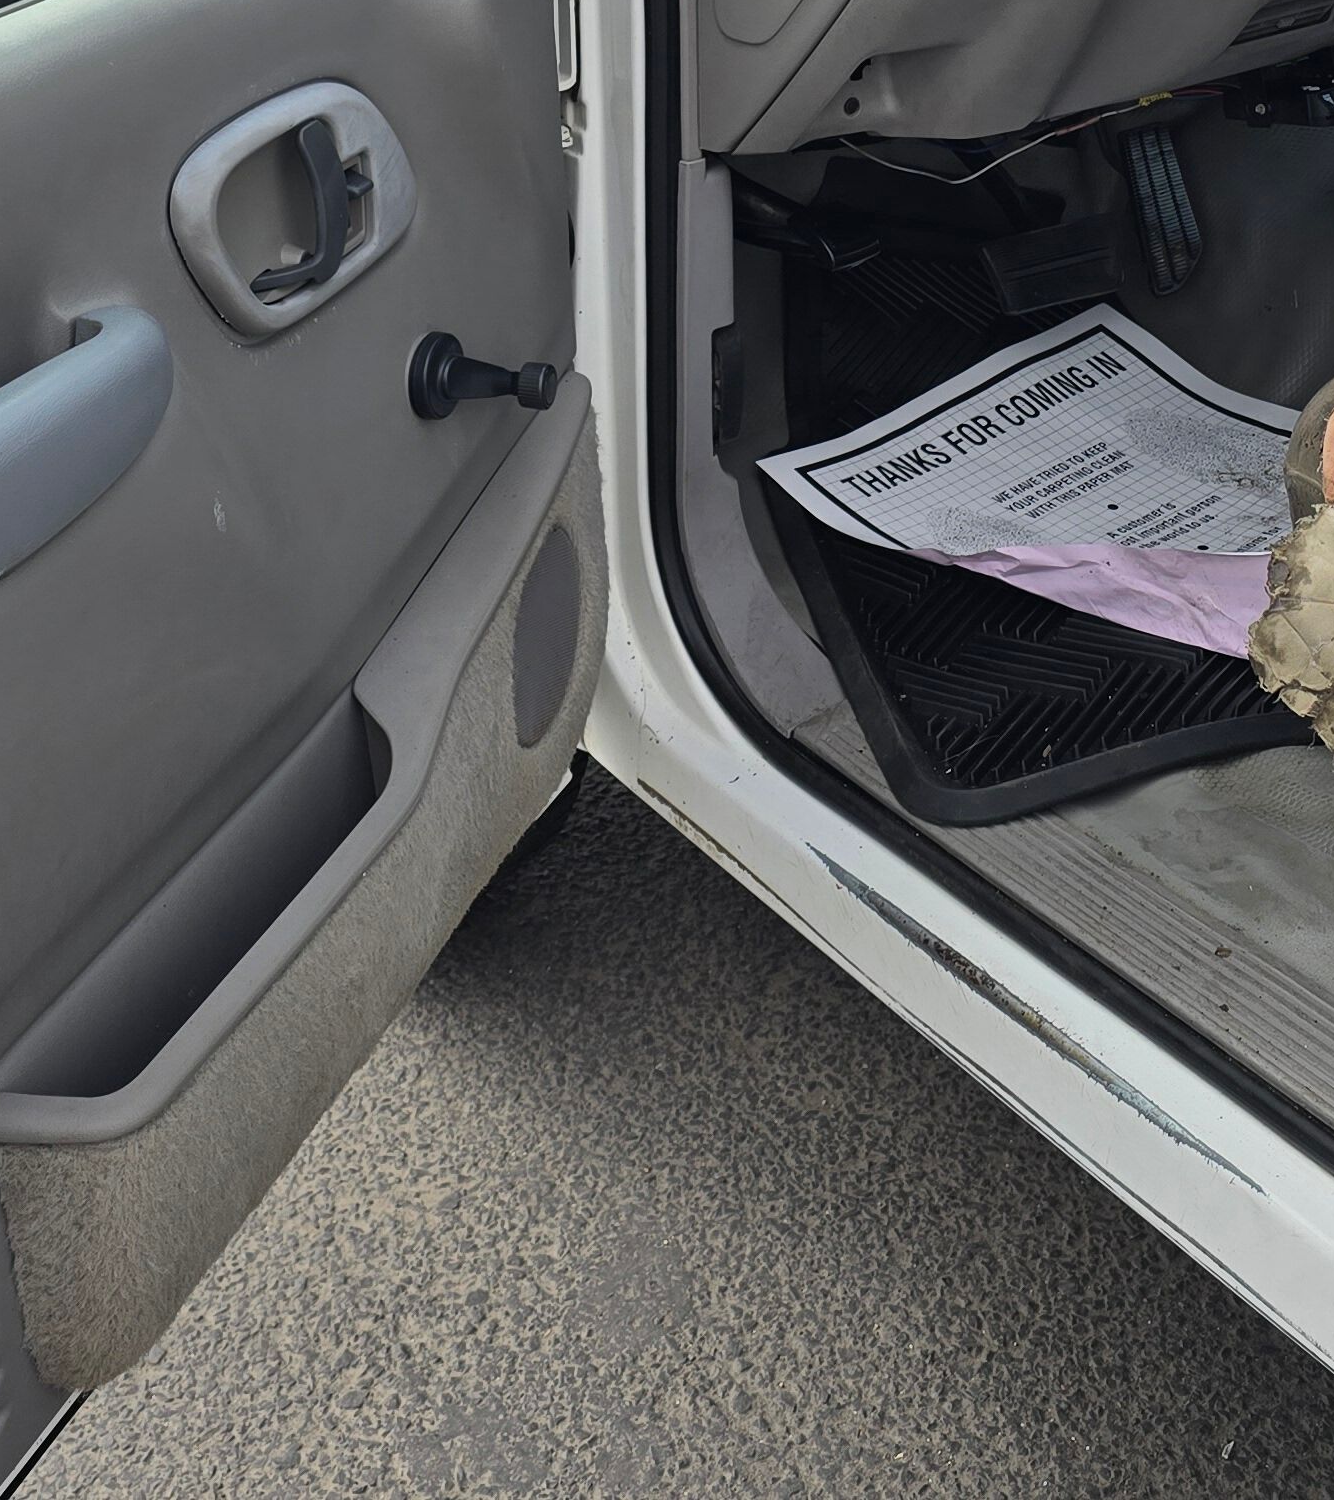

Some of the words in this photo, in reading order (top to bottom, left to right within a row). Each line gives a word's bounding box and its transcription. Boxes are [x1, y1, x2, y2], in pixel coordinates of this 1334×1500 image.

[841, 443, 952, 498] THANKS
[941, 415, 1007, 455] FOR
[995, 366, 1099, 426] COMING
[1086, 351, 1127, 380] IN
[992, 490, 1013, 504] WE
[1009, 477, 1041, 497] HAVE
[1036, 462, 1070, 482] TRIED
[1066, 454, 1085, 466] TO
[1082, 441, 1109, 459] KEEP
[1006, 495, 1039, 513] YOUR
[1036, 465, 1094, 498] CARPETING
[1090, 450, 1127, 470] CLEAN
[1025, 501, 1058, 519] WITH
[1053, 488, 1081, 505] THIS
[1078, 471, 1115, 494] PAPER
[1110, 460, 1135, 476] MAT
[1106, 531, 1120, 540] A
[1117, 509, 1165, 534] customer
[1160, 501, 1177, 516] is
[1133, 511, 1190, 542] important
[1186, 494, 1222, 520] person
[1157, 526, 1187, 543] world
[1186, 520, 1203, 531] to
